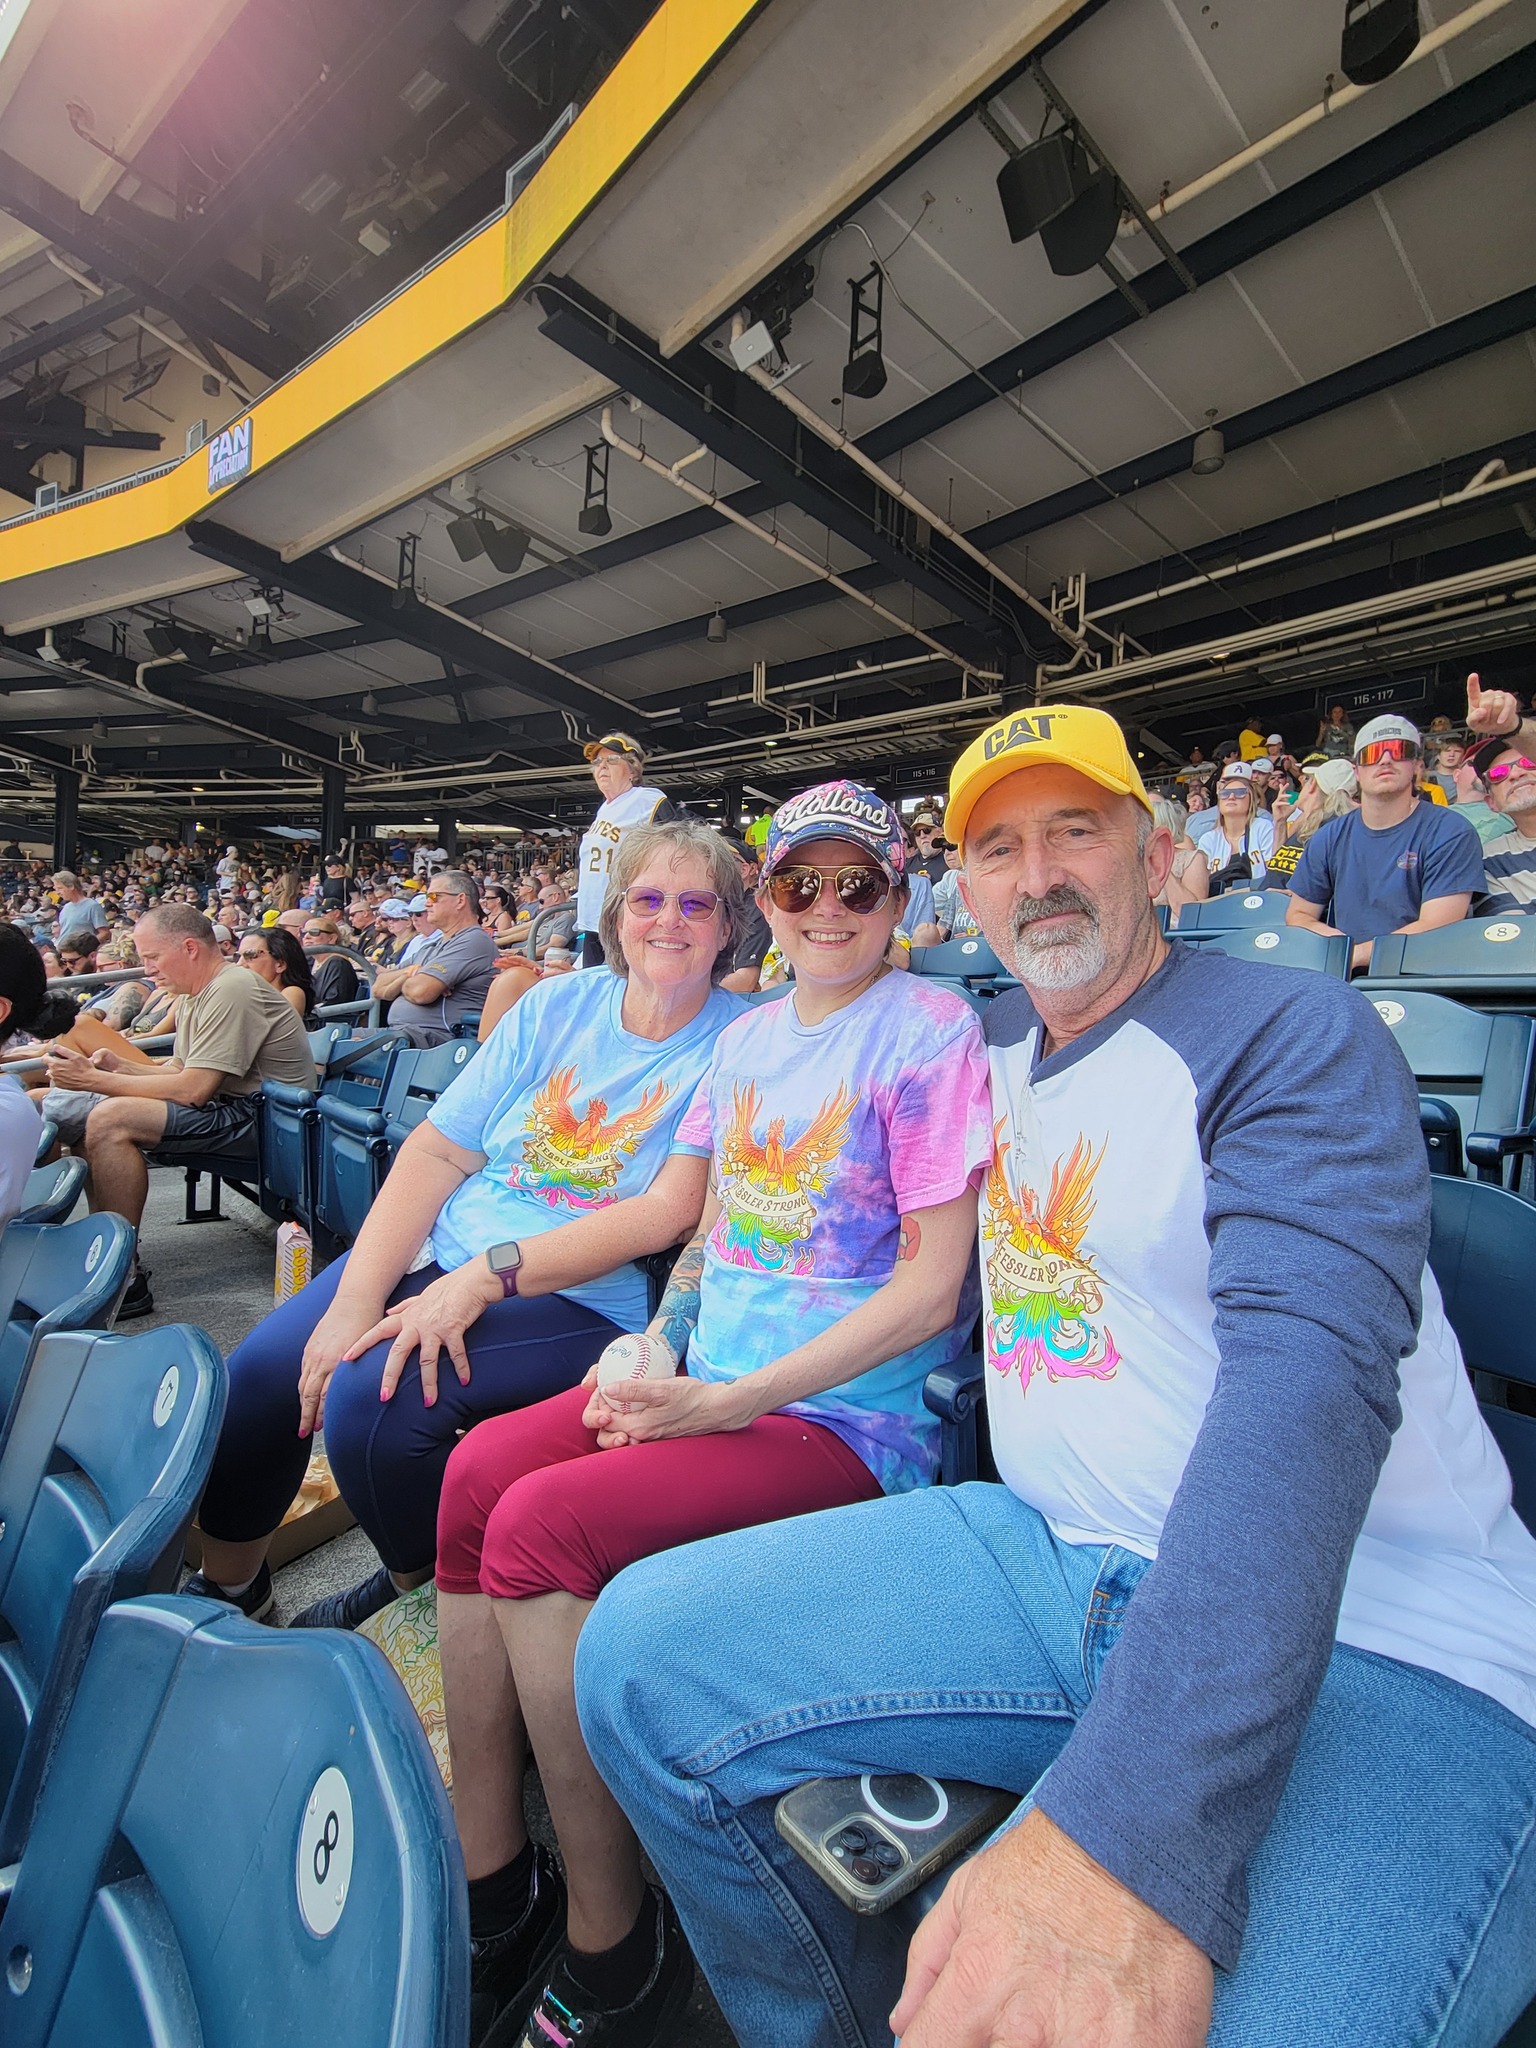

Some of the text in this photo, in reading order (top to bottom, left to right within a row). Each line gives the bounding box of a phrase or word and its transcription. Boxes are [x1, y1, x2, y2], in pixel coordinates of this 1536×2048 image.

[209, 418, 250, 469] FAN
[984, 714, 1056, 761] CAT
[778, 789, 892, 829] Holland
[590, 846, 614, 873] 21
[1264, 936, 1271, 944] 7
[1496, 927, 1508, 937] 8
[762, 1194, 808, 1212] STRONG
[165, 1380, 175, 1409] 7
[314, 1810, 340, 1885] 8
